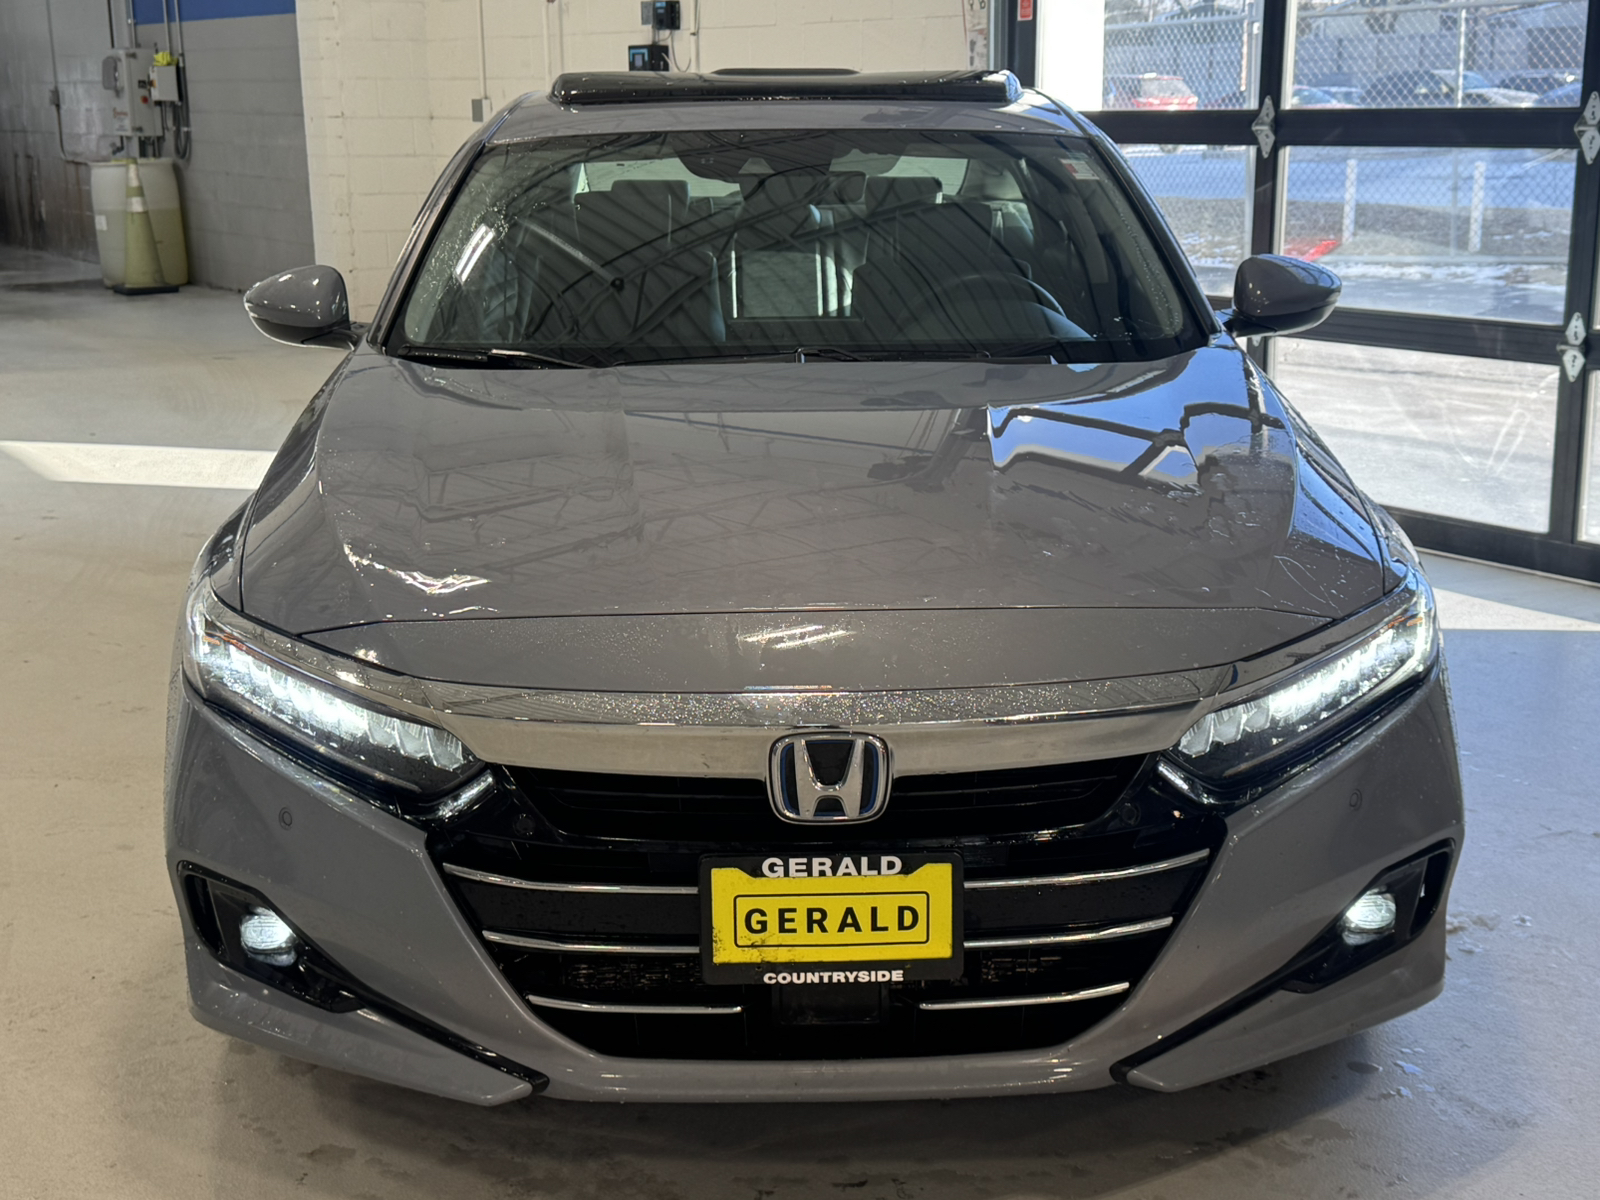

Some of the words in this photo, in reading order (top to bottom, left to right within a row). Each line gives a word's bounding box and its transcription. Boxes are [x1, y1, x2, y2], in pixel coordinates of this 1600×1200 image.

[761, 855, 903, 878] GERALD
[744, 905, 920, 935] GERALD
[763, 969, 904, 985] COUNTRYSIDE
